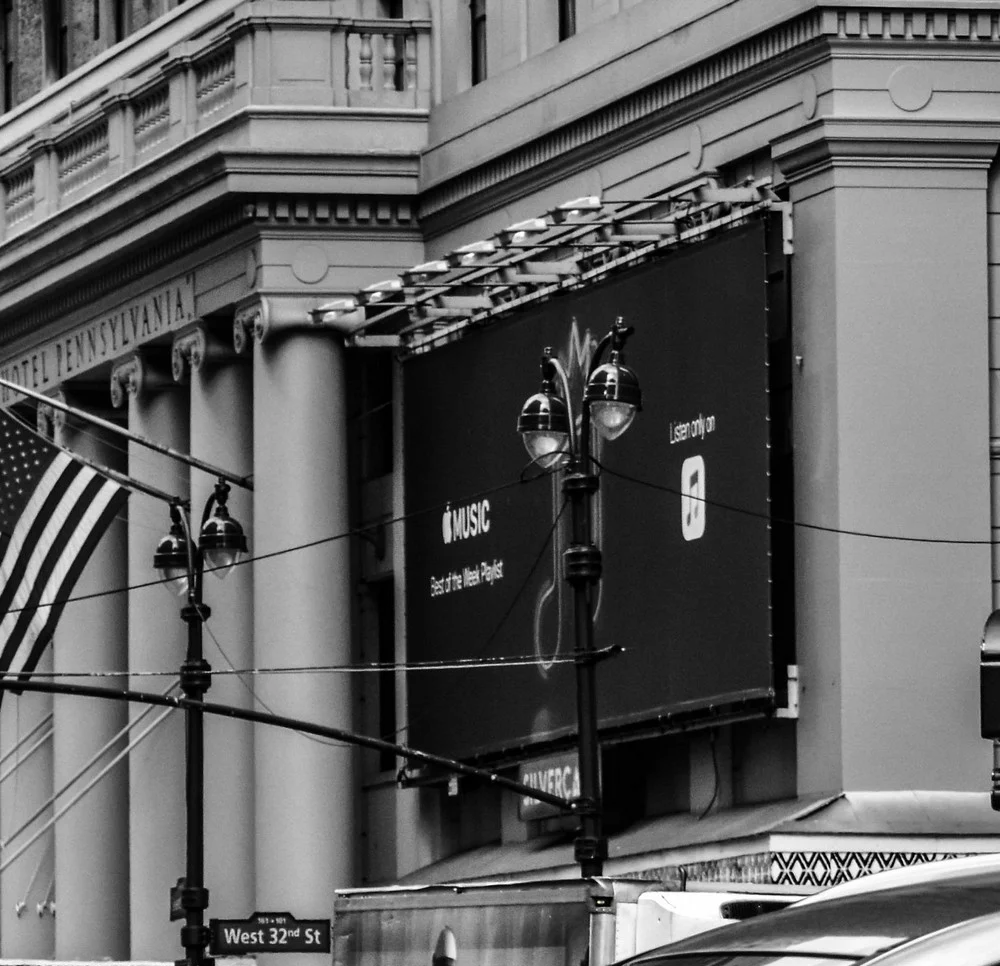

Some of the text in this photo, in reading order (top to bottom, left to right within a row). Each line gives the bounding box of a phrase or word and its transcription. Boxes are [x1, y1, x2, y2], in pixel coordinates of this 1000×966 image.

[669, 413, 716, 444] Listen only on
[453, 499, 490, 542] MUSIC
[431, 559, 503, 597] Best of the Week Playlist
[224, 926, 321, 945] West 32nd St
